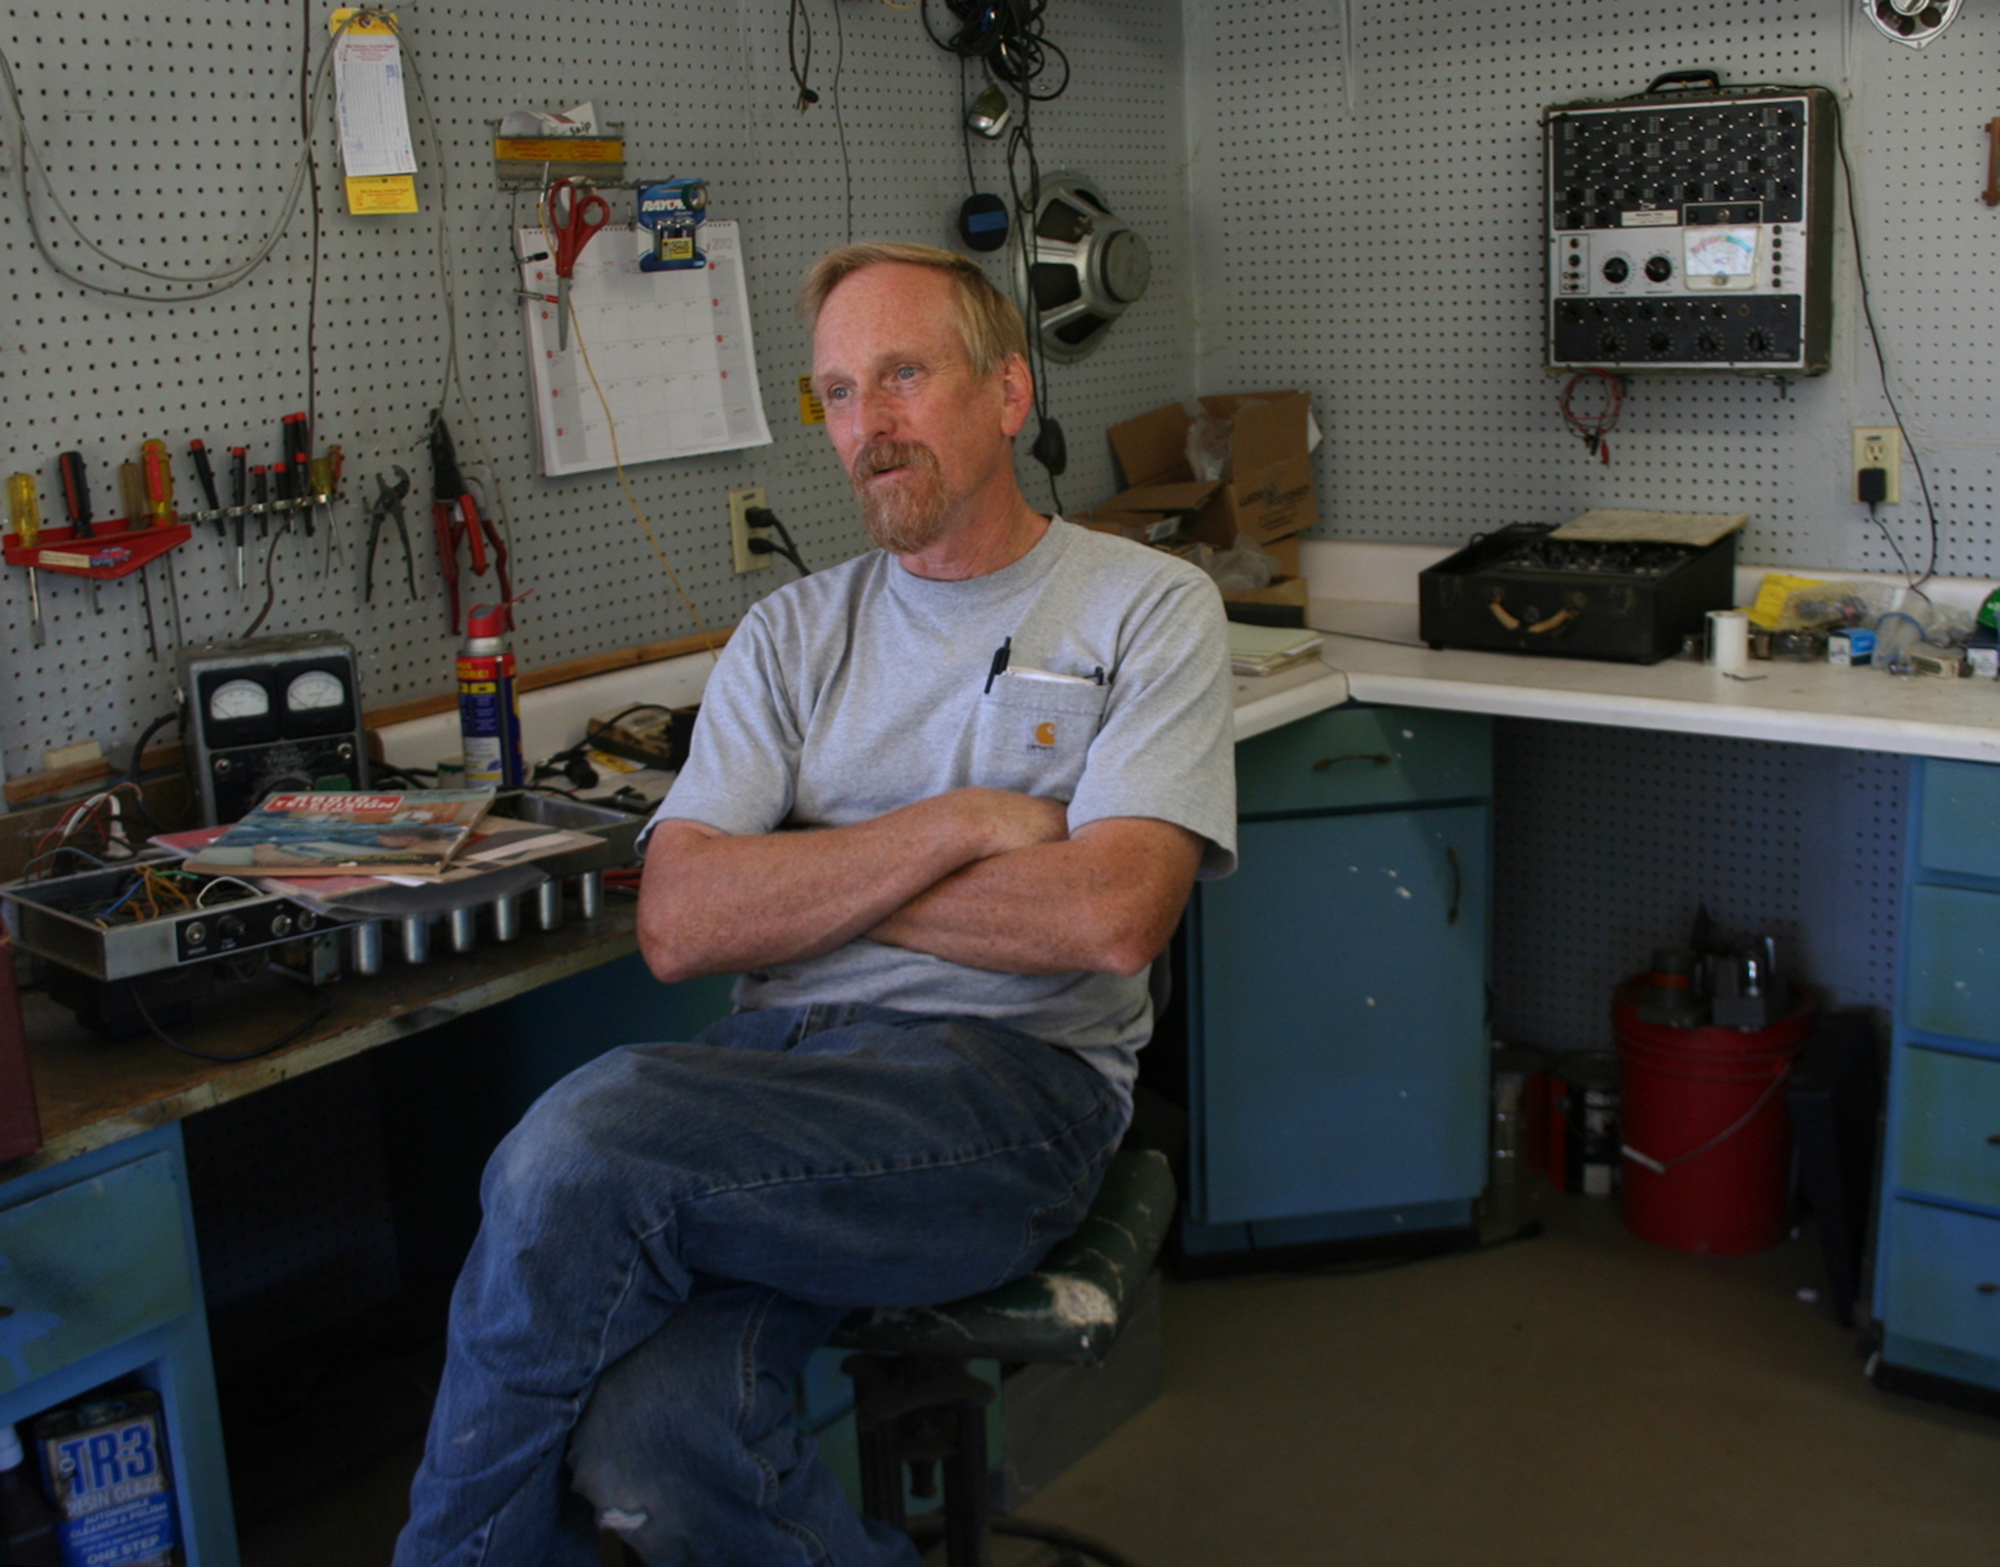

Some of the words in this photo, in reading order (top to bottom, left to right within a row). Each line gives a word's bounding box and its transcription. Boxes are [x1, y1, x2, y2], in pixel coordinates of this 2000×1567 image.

[67, 1491, 111, 1517] RESIN
[113, 1474, 164, 1503] GLAZE
[69, 1516, 119, 1539] CLEANER
[129, 1502, 168, 1520] POLISH
[86, 1546, 120, 1565] ONE
[121, 1533, 160, 1555] STEP
